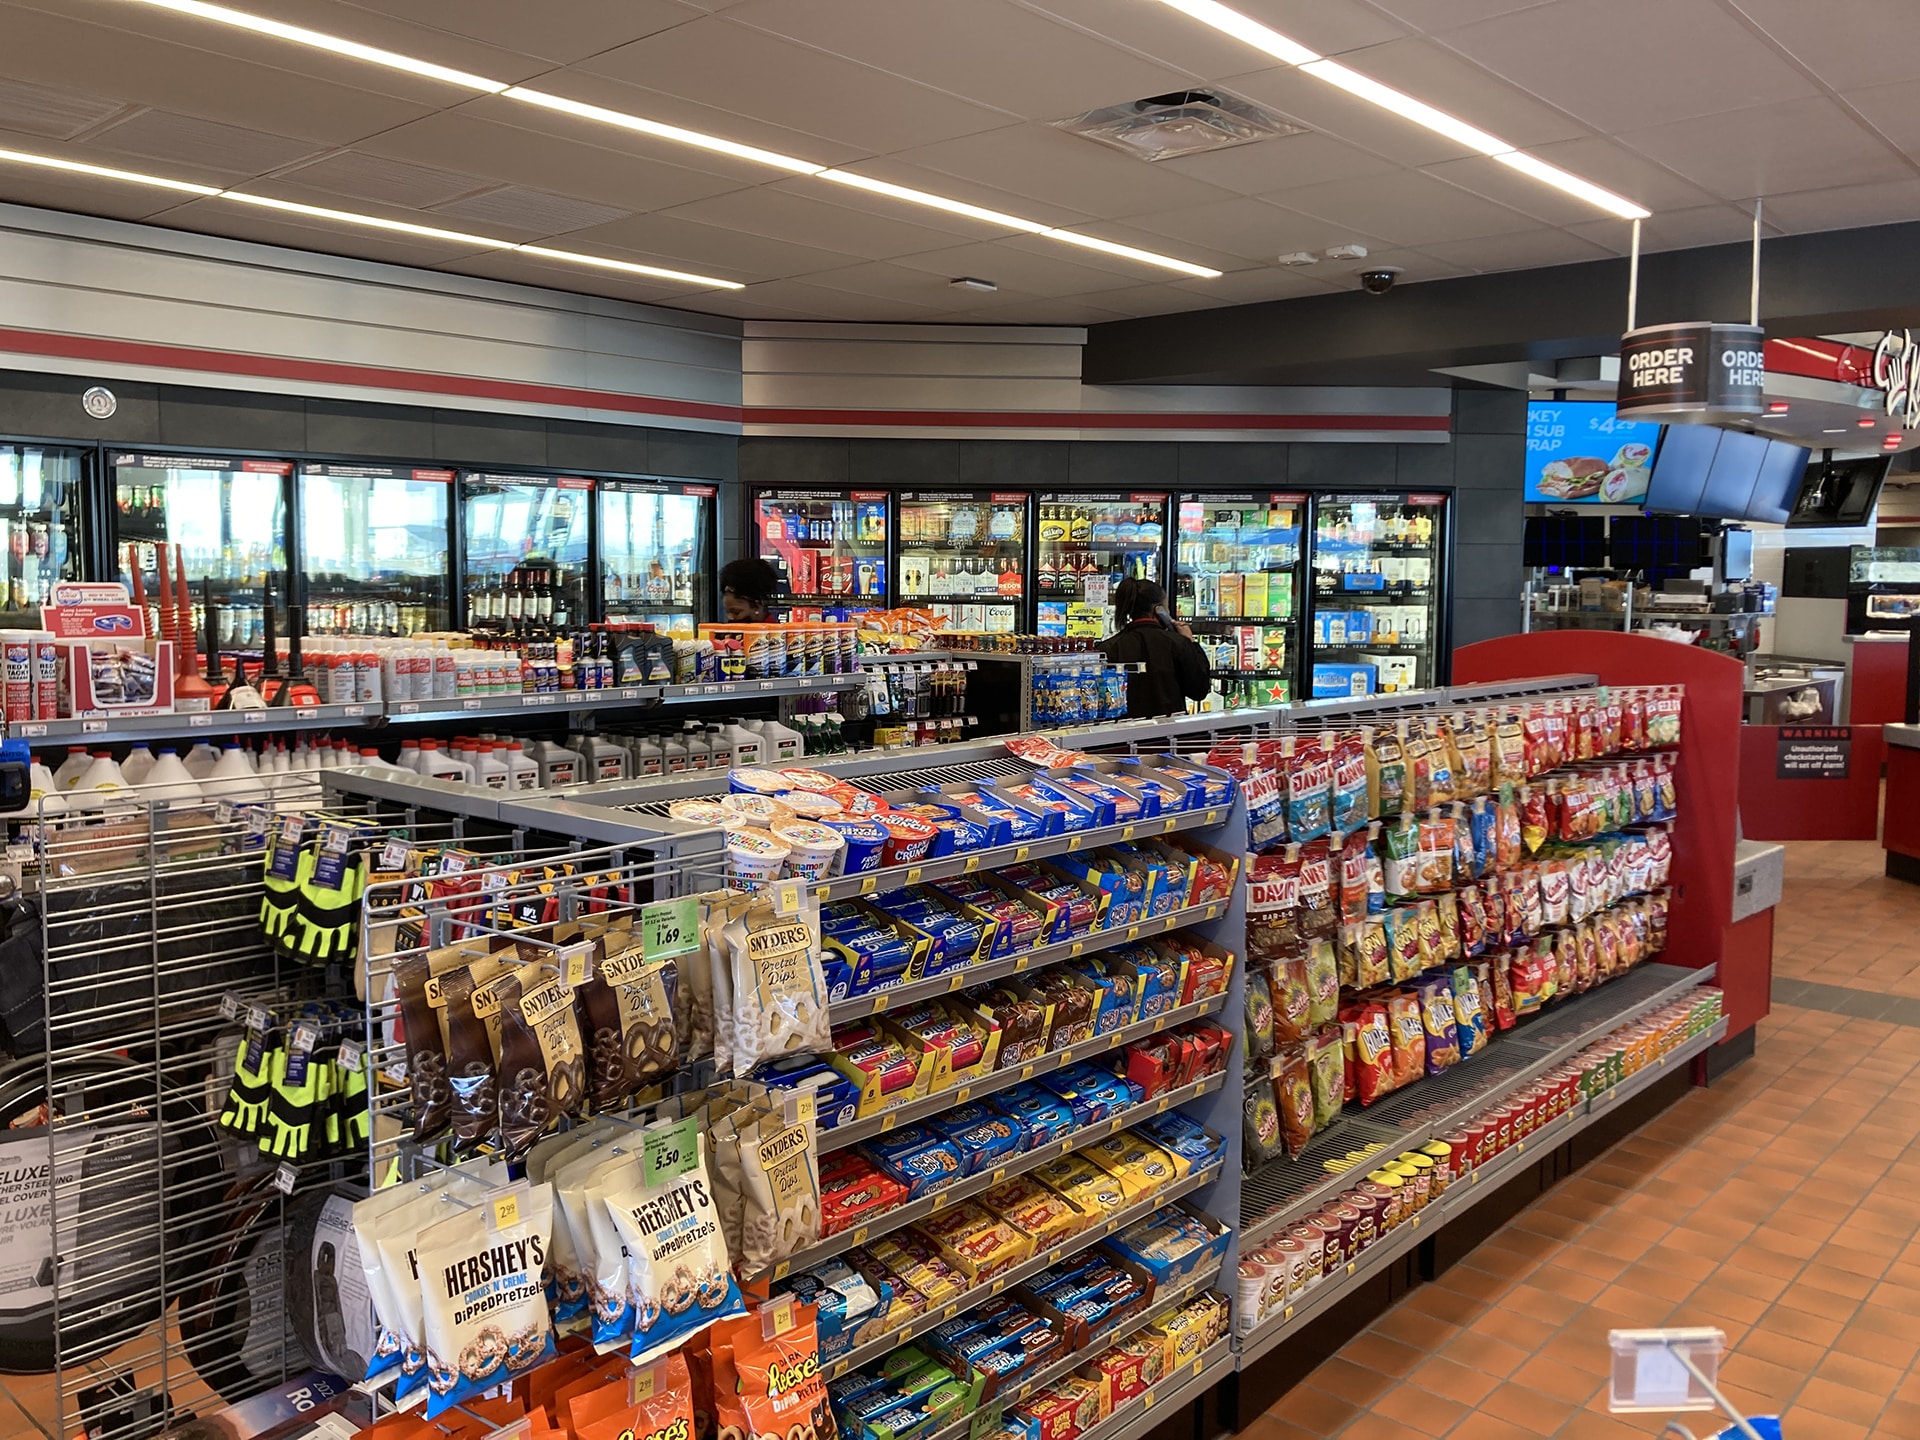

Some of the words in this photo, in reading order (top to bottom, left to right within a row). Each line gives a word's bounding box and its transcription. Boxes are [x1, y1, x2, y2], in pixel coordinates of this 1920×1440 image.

[1629, 347, 1694, 371] ORDER
[1632, 366, 1684, 388] HERE
[1533, 424, 1565, 437] SUB
[1782, 729, 1849, 738] WARNING
[1784, 761, 1798, 769] will
[1811, 761, 1822, 769] off
[1825, 754, 1844, 762] entry
[782, 859, 825, 872] Cinnamon
[656, 928, 680, 946] 1.69
[750, 927, 807, 953] SNYDER'S
[942, 921, 973, 940] OREO
[761, 954, 798, 974] Pretzel
[933, 951, 944, 961] 10
[767, 969, 796, 986] Dips
[859, 969, 871, 980] 10
[920, 1021, 952, 1039] OREO
[848, 1043, 883, 1063] OREO
[760, 1128, 804, 1164] SNYDER'S
[655, 1149, 679, 1171] 5.50
[773, 1157, 798, 1182] Pretzel
[778, 1173, 798, 1193] Dips
[13, 1189, 48, 1202] COVER
[631, 1179, 710, 1237] HERSHEY'S
[444, 1233, 546, 1300] HERSHEY'S
[464, 1284, 492, 1306] COOKIES
[502, 1272, 528, 1290] CREME
